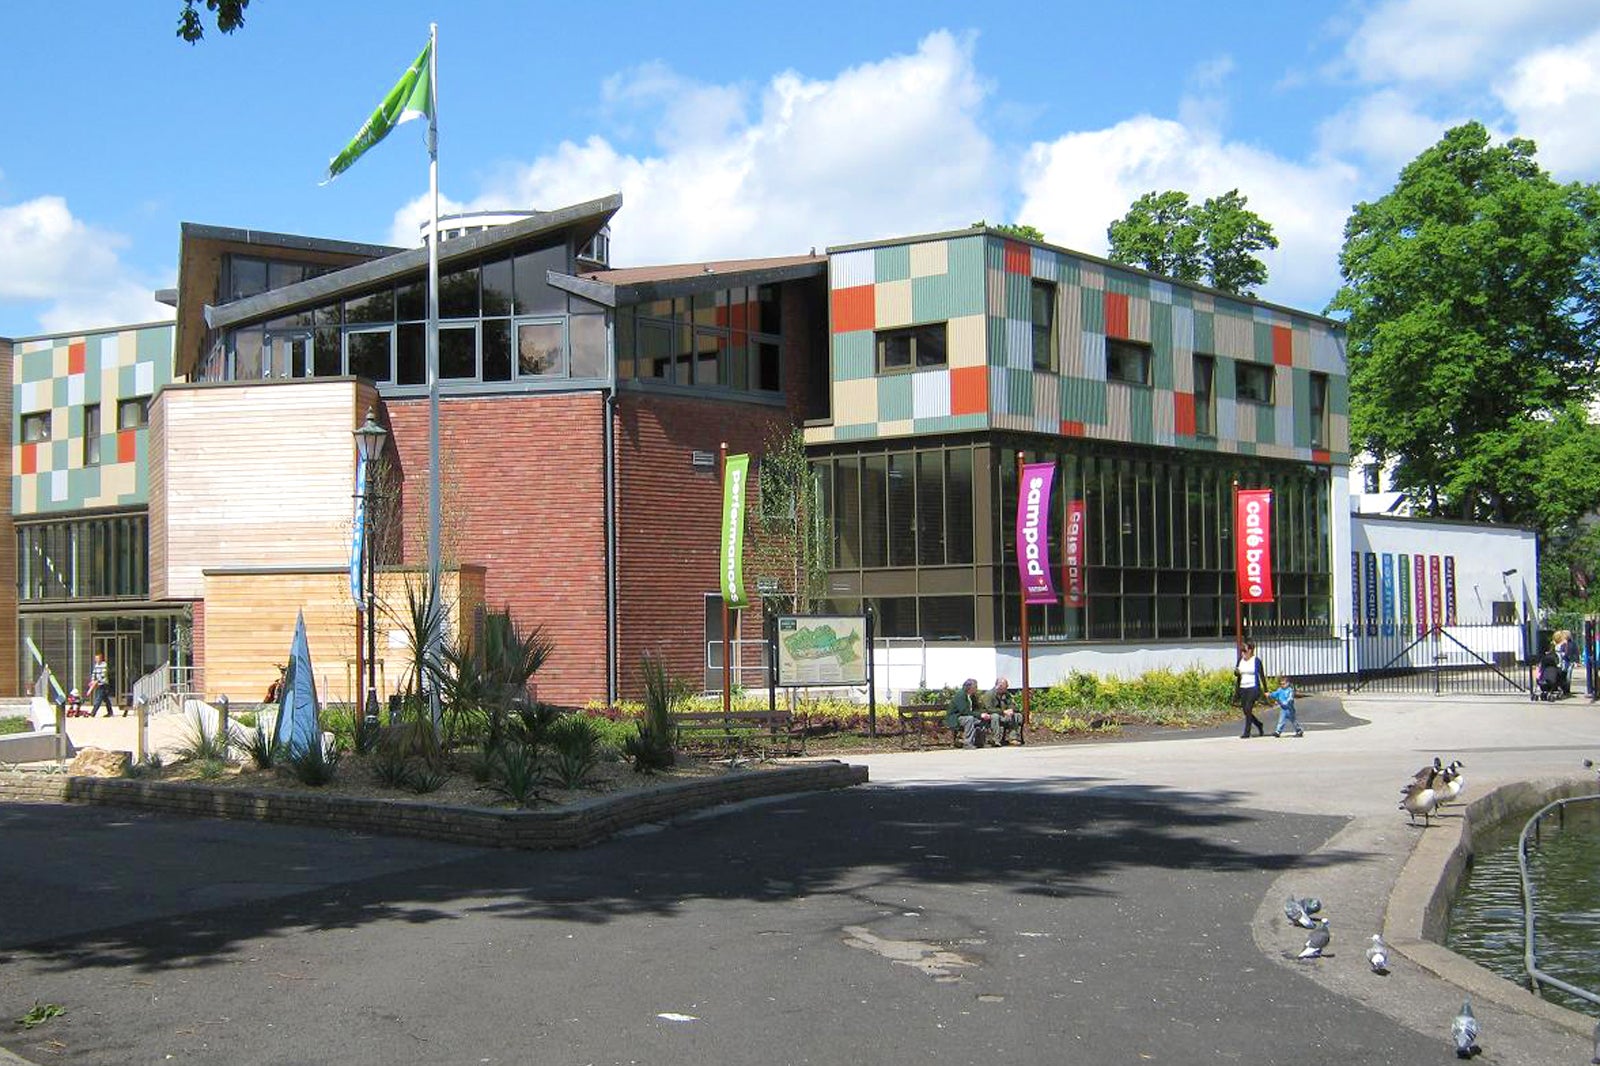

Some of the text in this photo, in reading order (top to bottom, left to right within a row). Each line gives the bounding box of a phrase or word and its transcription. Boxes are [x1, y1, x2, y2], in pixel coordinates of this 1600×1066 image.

[727, 470, 742, 603] performances
[1022, 477, 1044, 577] sampad
[1246, 501, 1264, 583] café bar
